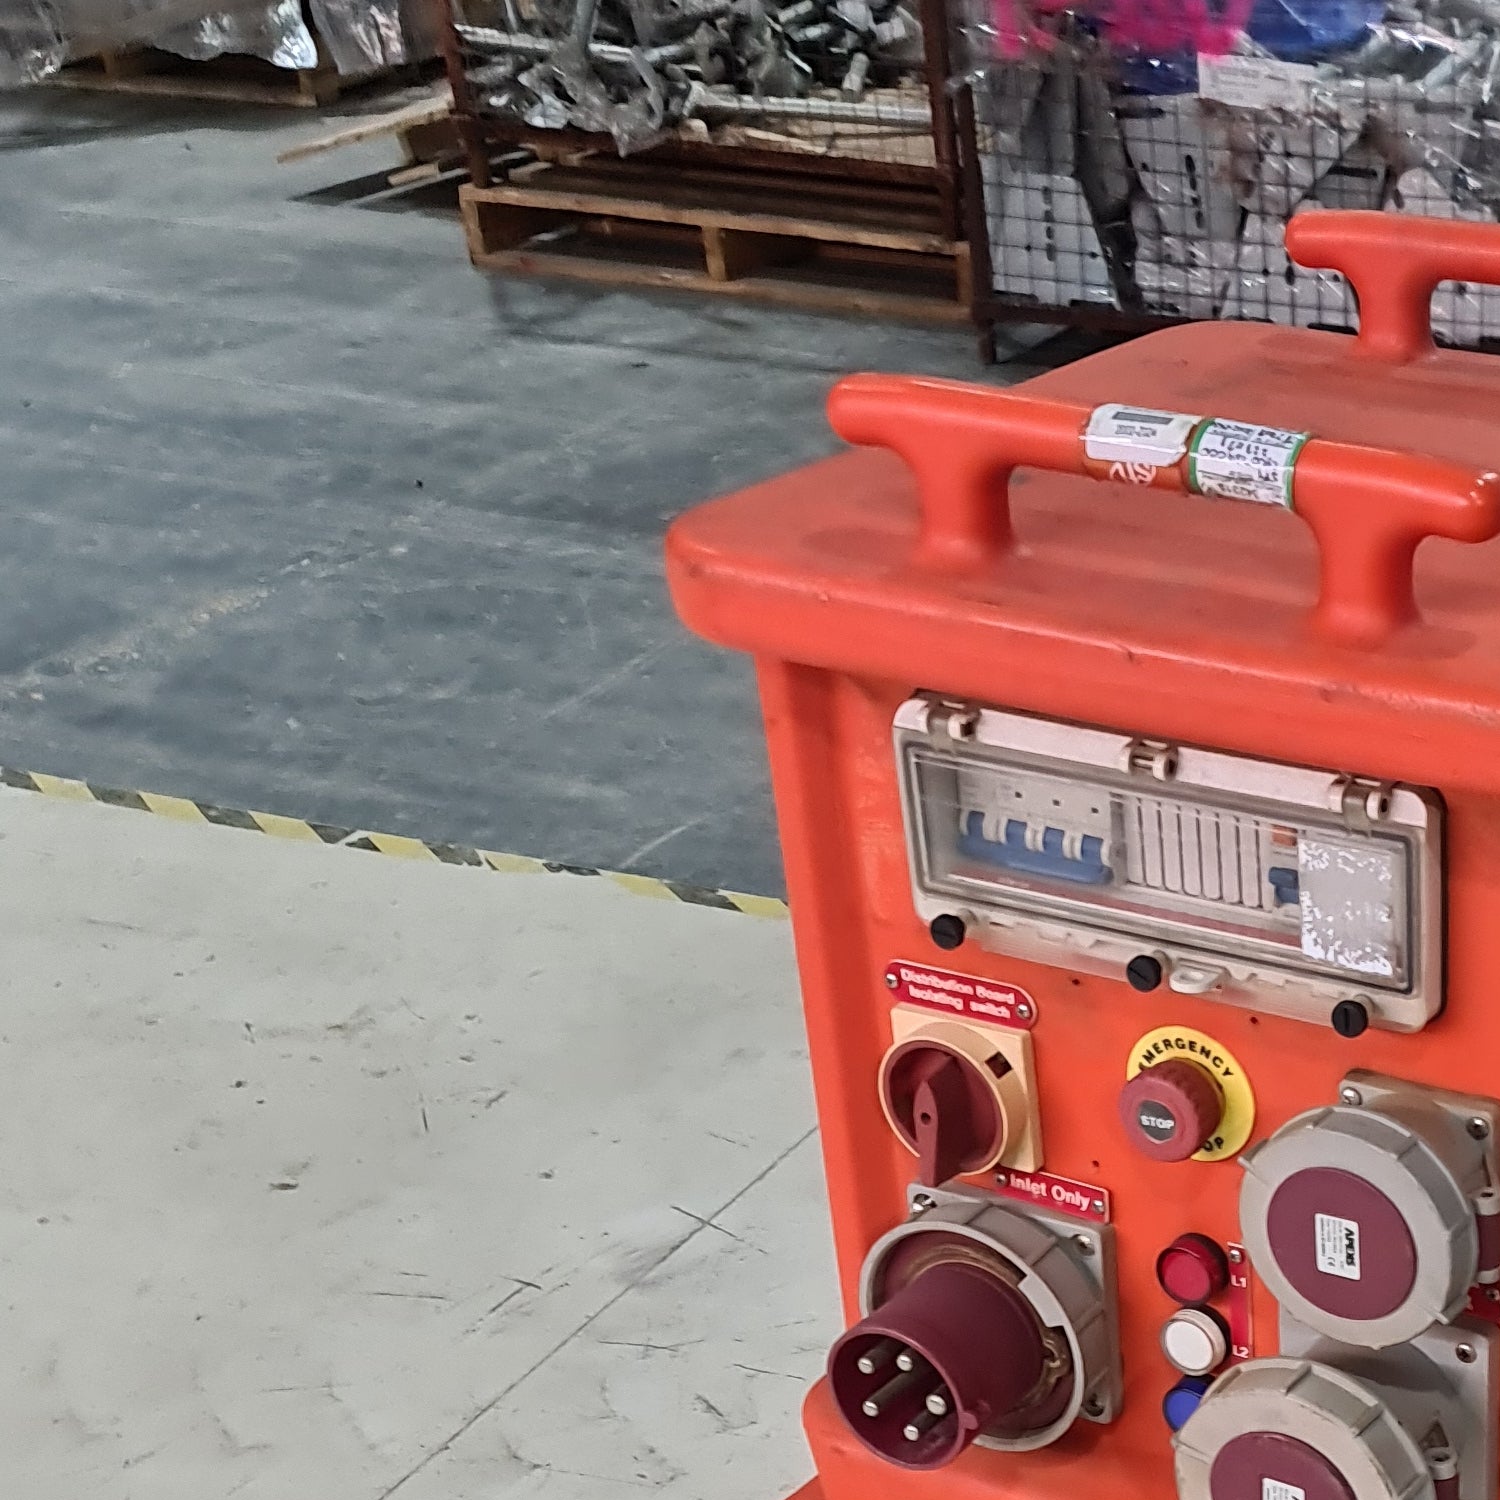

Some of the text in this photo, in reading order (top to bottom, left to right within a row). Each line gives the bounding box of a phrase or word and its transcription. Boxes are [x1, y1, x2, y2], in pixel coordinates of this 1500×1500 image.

[900, 968, 1015, 1004] Distribution Board
[908, 985, 1011, 1018] Isolating switch
[1140, 1115, 1175, 1129] STOP
[1201, 1136, 1225, 1152] OP
[1010, 1173, 1090, 1211] Inlet Only
[1231, 1275, 1247, 1288] L1
[1232, 1345, 1249, 1359] L2
